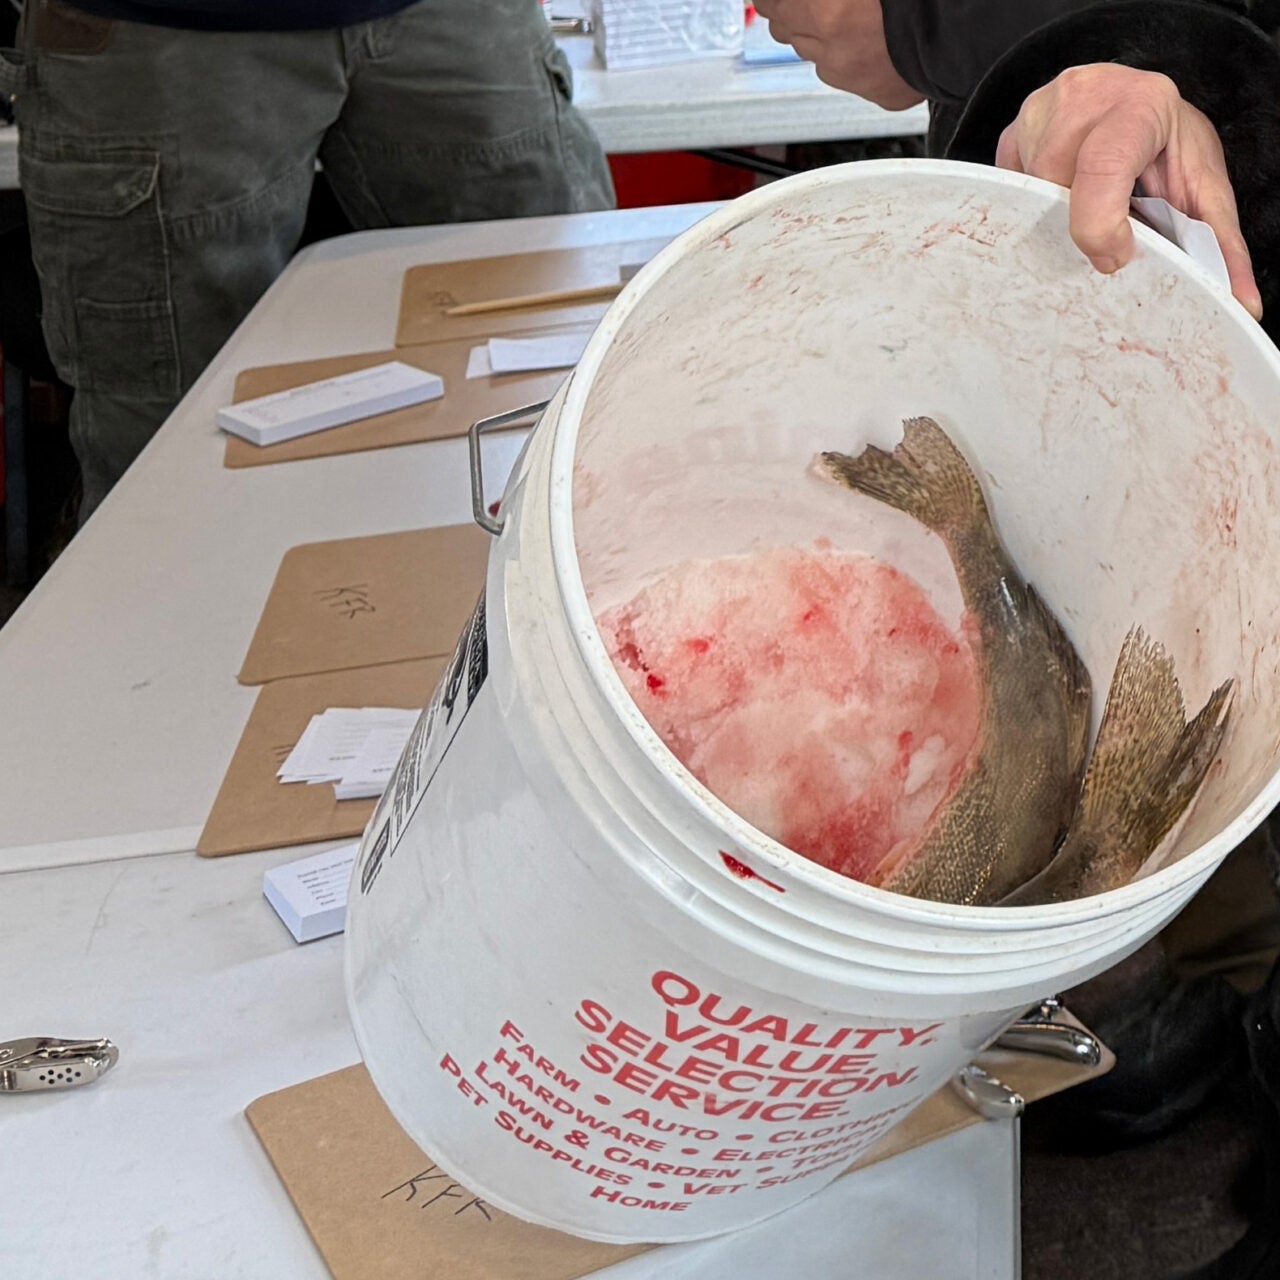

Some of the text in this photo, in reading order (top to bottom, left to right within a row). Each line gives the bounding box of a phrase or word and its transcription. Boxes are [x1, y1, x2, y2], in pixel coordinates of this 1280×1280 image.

[499, 1019, 582, 1093] FARM
[622, 1107, 721, 1141] AUTO
[574, 999, 920, 1098] SELECTION,
[579, 1042, 851, 1122] SERVICE.
[665, 1009, 878, 1076] VALUE,
[439, 1052, 489, 1107] PET
[494, 1110, 634, 1186] SUPPLIES
[682, 1182, 749, 1196] VET
[474, 1060, 555, 1131] LAWN
[563, 1128, 591, 1152] &
[603, 1146, 742, 1180] GARDEN
[493, 1047, 668, 1153] HARDWARE
[589, 1185, 693, 1212] HOME
